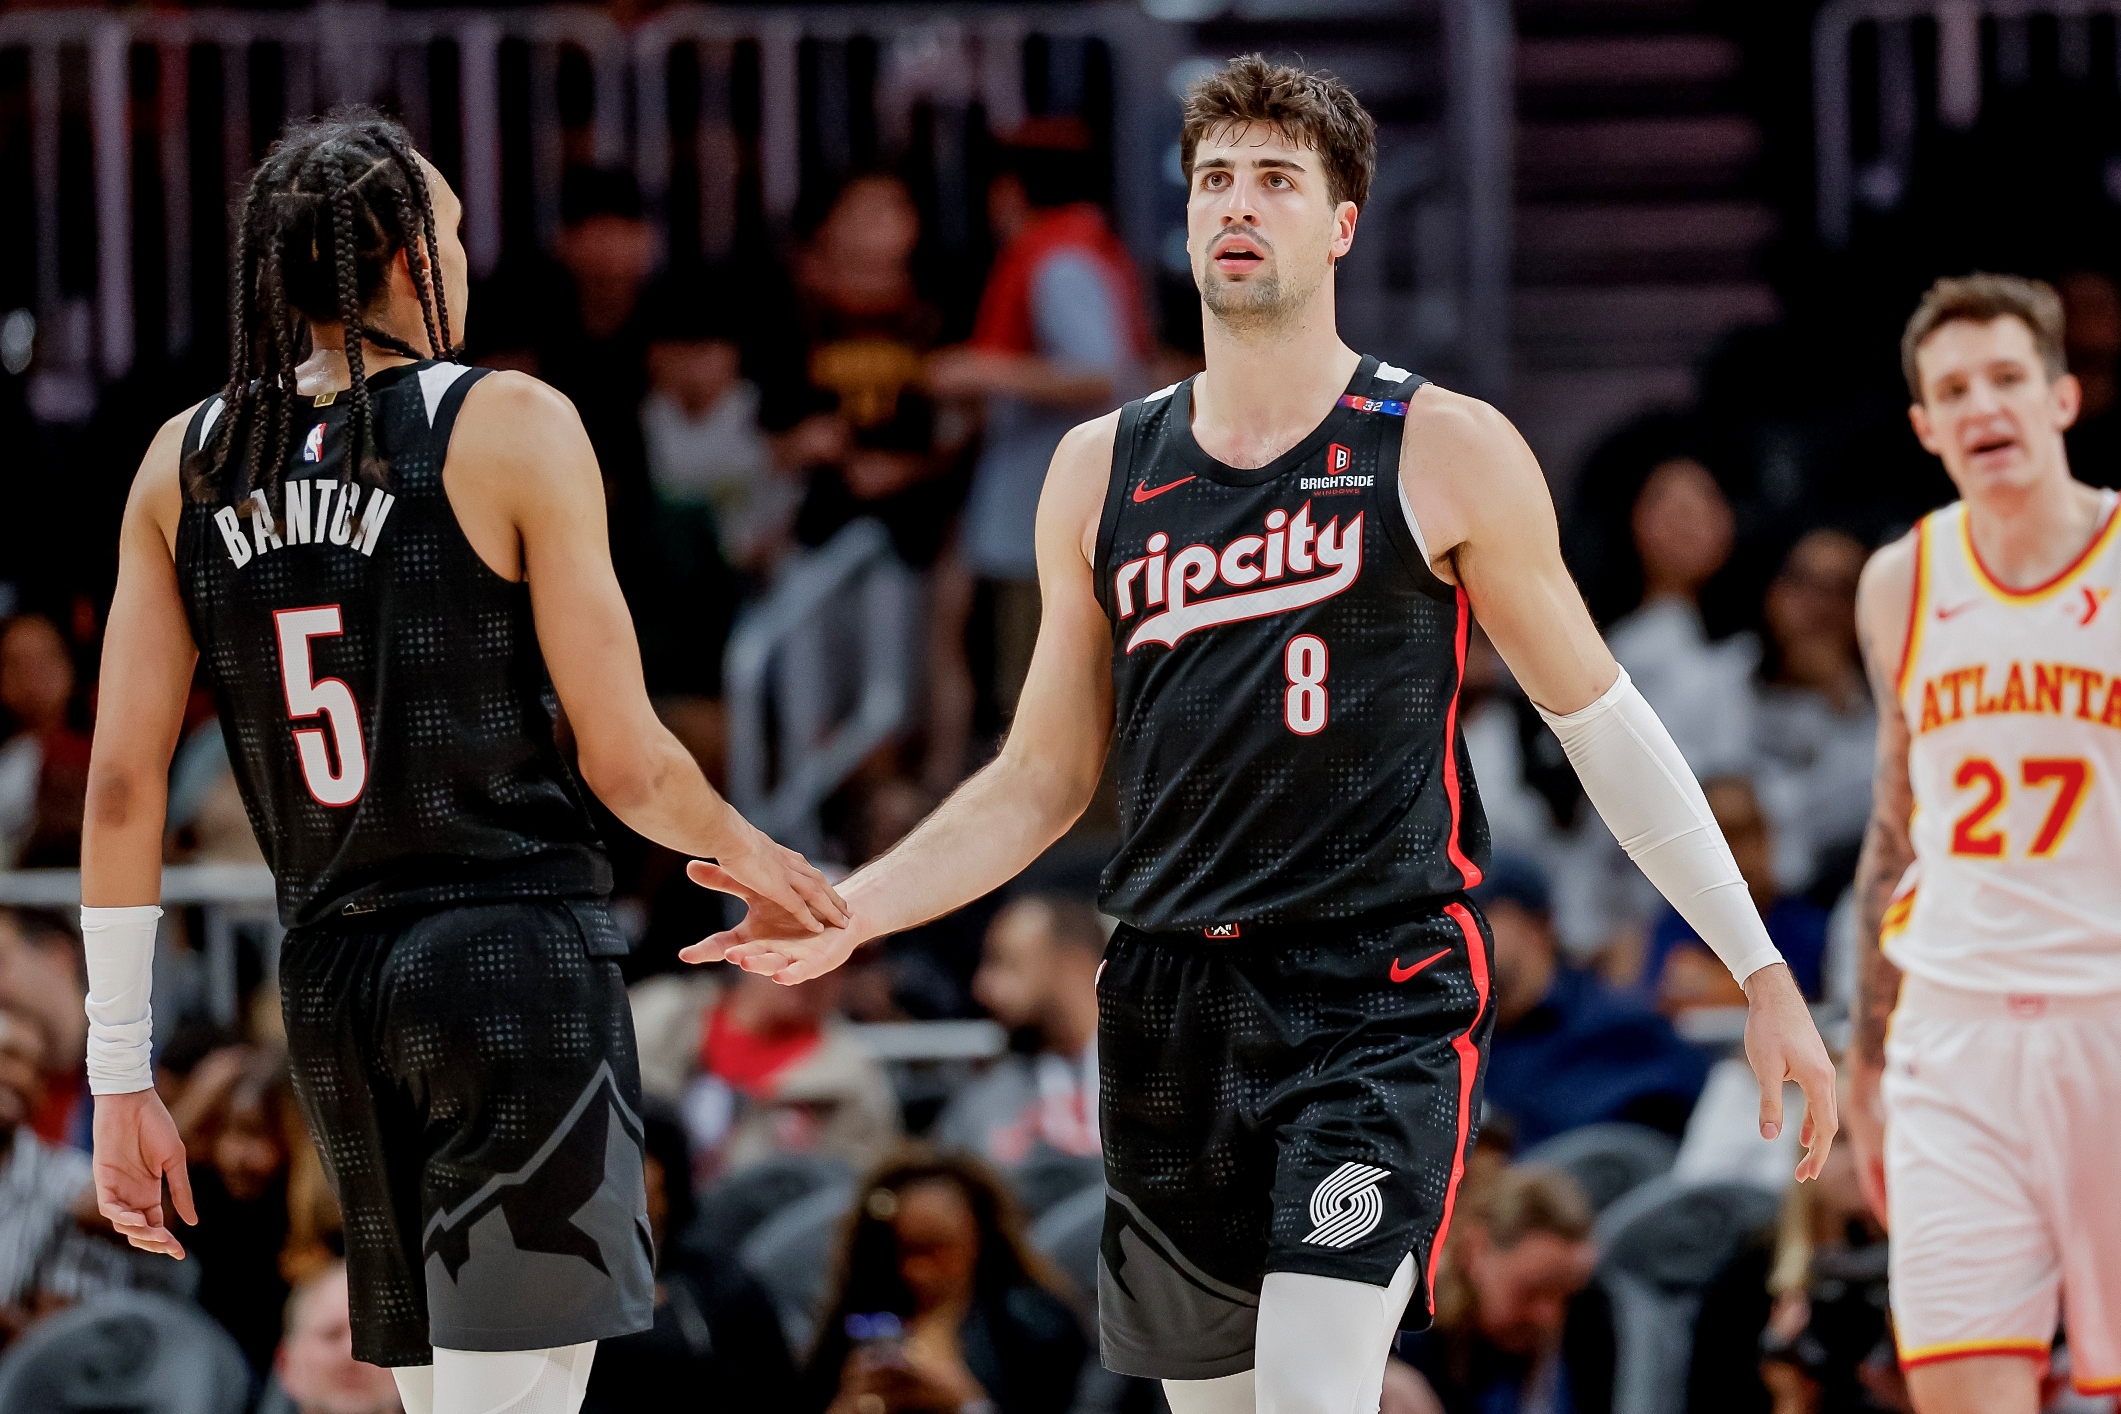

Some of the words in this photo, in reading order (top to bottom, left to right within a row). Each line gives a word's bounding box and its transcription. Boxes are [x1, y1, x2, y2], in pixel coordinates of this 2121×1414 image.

[1363, 401, 1384, 412] 32
[1300, 475, 1375, 490] BRIGHTSIDE
[1313, 488, 1360, 497] WINDOWS
[1336, 449, 1347, 469] B
[213, 479, 396, 569] BANTON
[273, 604, 368, 807] 5
[1284, 633, 1329, 736] 8
[1920, 660, 2121, 733] ATLANTA
[1949, 757, 2094, 860] 27
